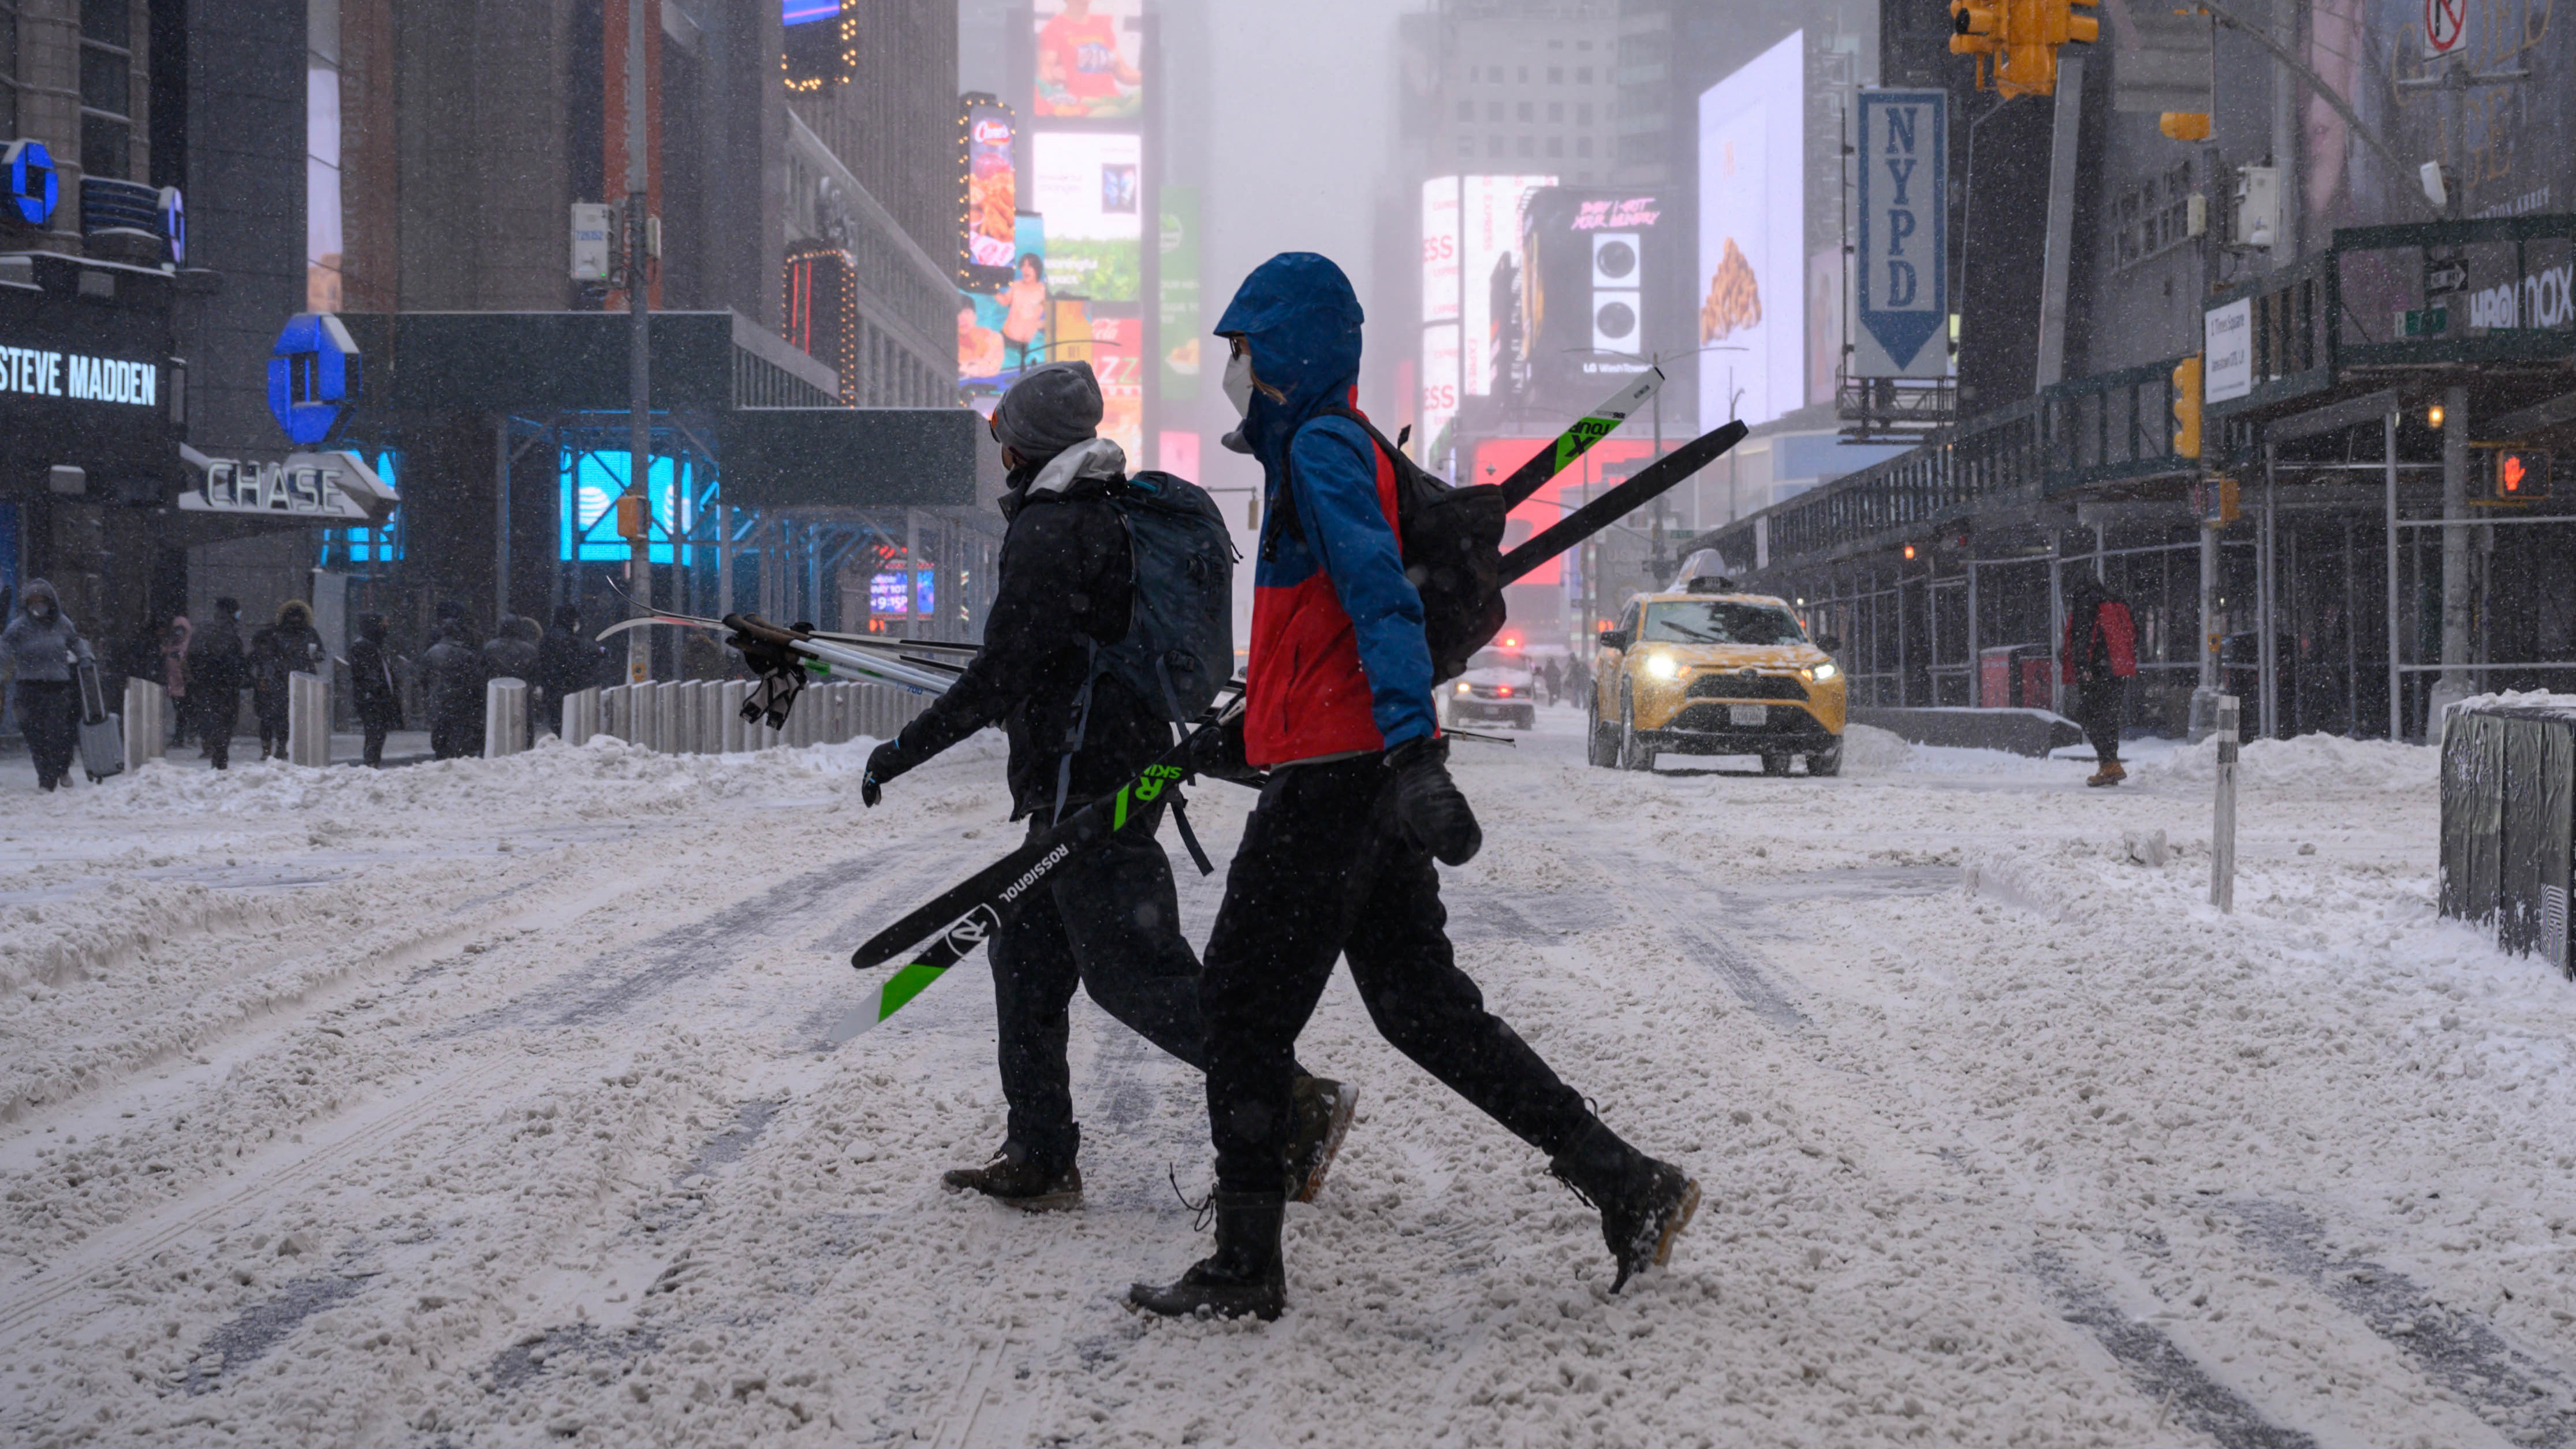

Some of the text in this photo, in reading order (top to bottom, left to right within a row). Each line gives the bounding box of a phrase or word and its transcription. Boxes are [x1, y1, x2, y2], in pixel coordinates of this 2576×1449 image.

[1885, 107, 1917, 307] NYPD
[0, 345, 155, 406] STEVE MADDEN
[1583, 363, 1598, 373] LG
[1564, 434, 1595, 458] X
[208, 461, 345, 515] CHASE
[998, 843, 1070, 903] ROSSIGNOL
